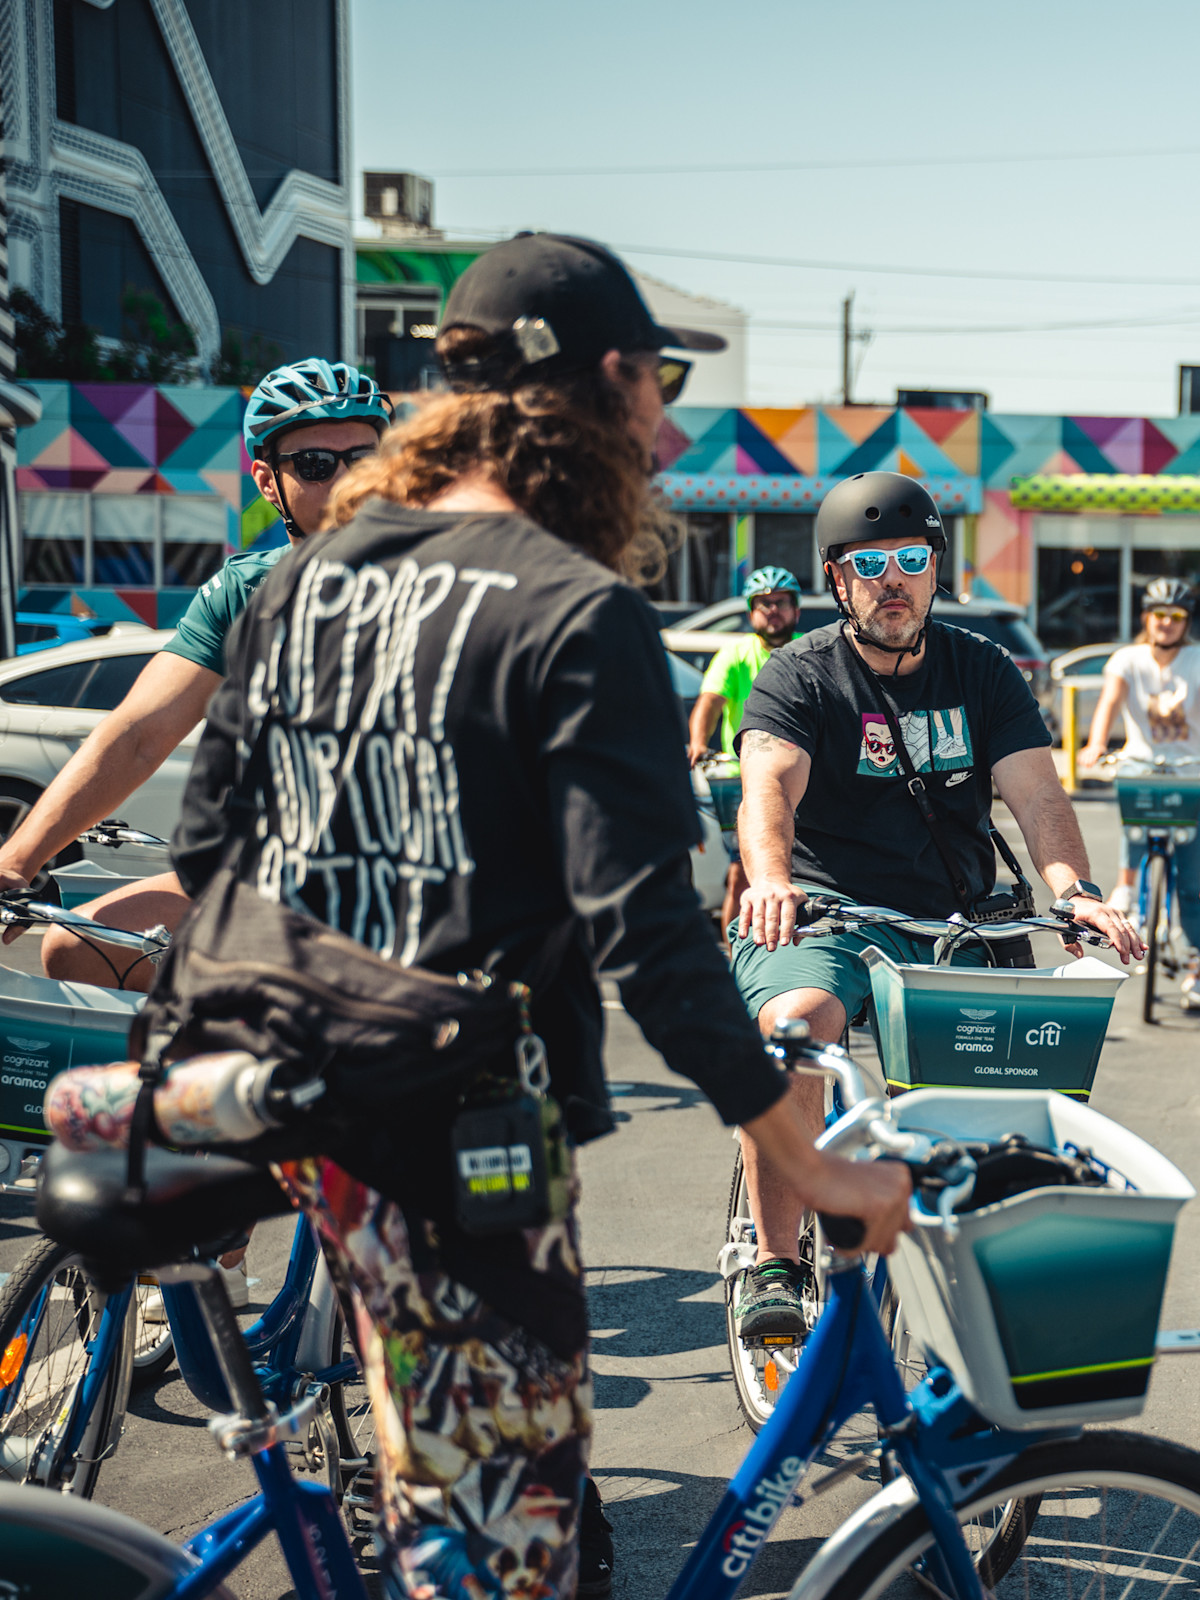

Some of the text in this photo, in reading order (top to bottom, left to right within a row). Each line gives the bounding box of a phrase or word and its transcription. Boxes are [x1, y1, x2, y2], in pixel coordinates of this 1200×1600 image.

[248, 558, 518, 742] UPPORT
[956, 1025, 996, 1035] cognizant
[1025, 1021, 1062, 1046] citi
[954, 1042, 994, 1053] aramco
[3, 1055, 50, 1069] cognizant
[974, 1066, 1039, 1077] GLOBAL SPONSOR
[1, 1075, 47, 1090] aramco
[24, 1103, 49, 1115] GLOB
